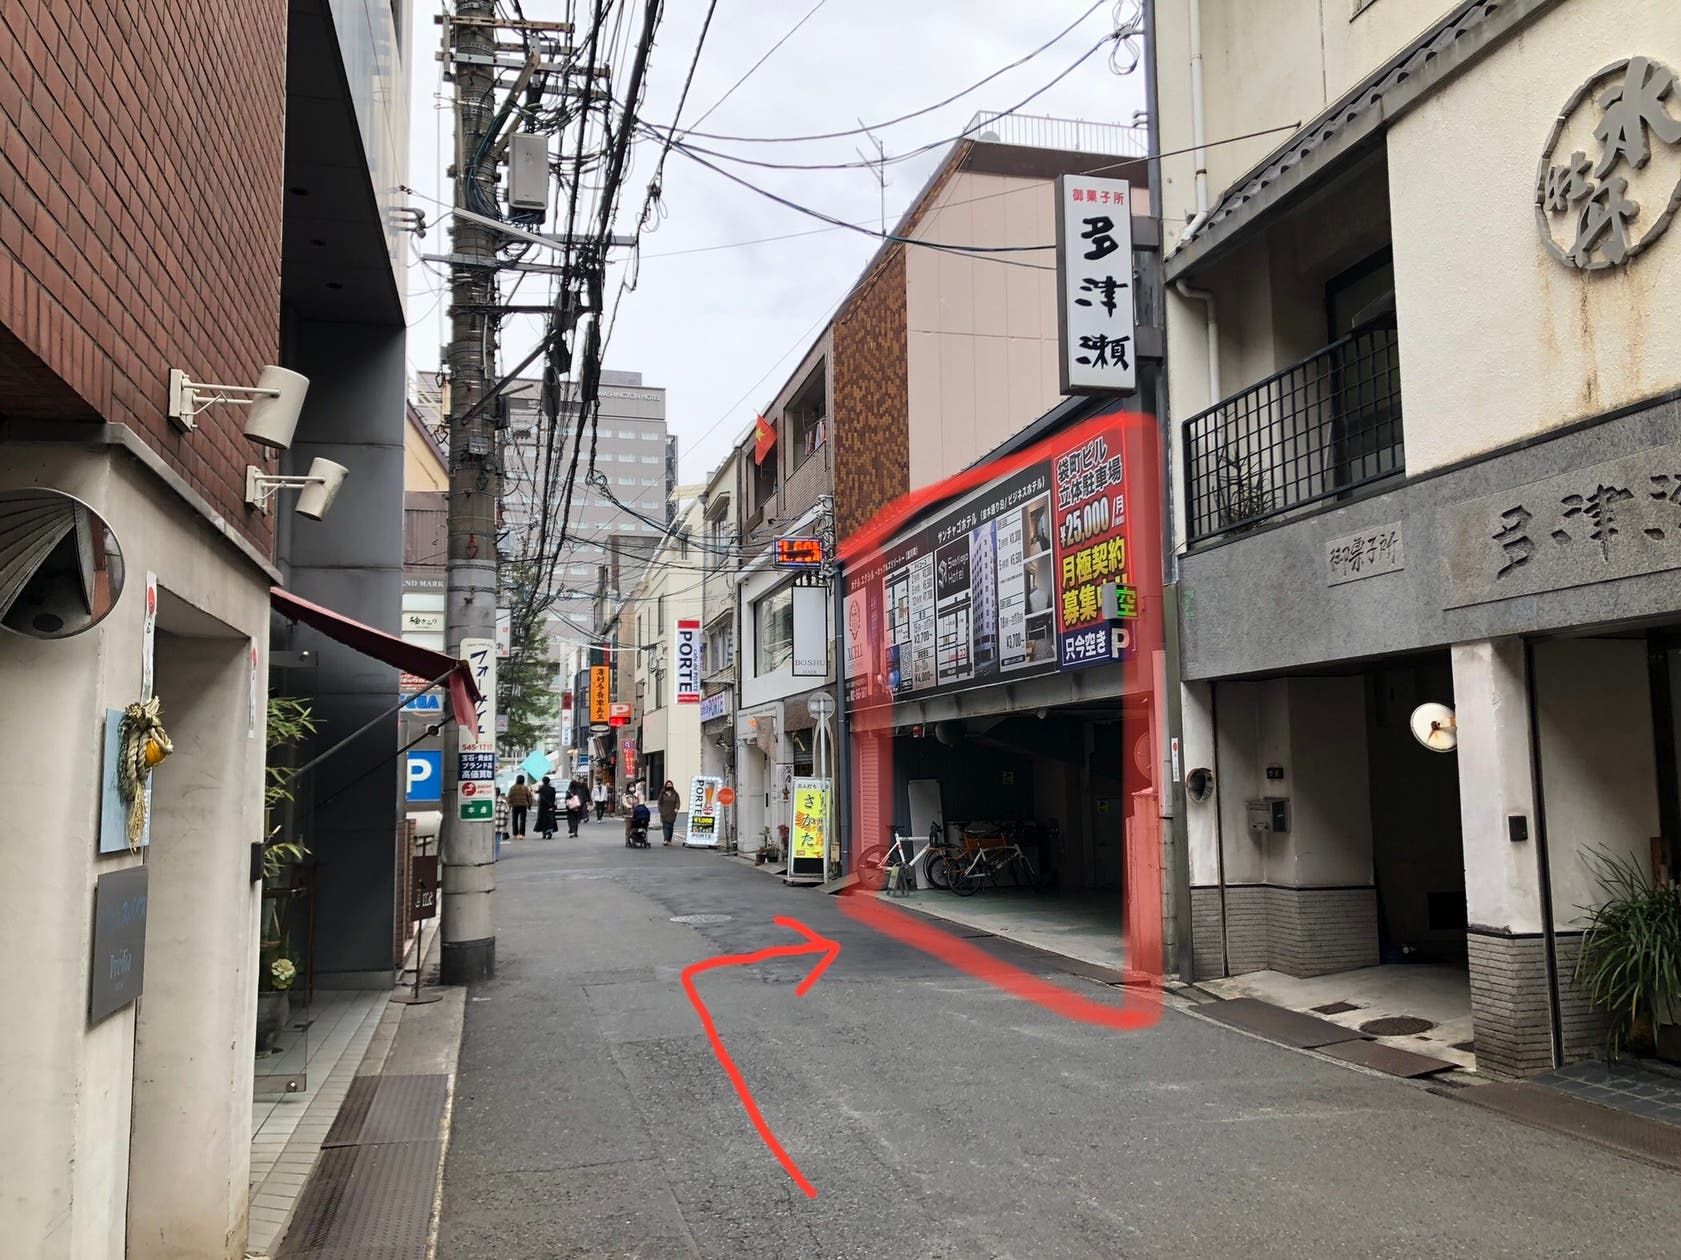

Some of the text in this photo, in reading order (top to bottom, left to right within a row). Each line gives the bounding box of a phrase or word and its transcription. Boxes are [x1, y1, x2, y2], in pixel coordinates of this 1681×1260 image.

[1072, 188, 1125, 205] 御菓子所
[1074, 216, 1130, 371] 多津瀬
[1058, 437, 1107, 485] 袋町ビル
[1058, 454, 1123, 511] 立体駐車場
[937, 512, 977, 544] サンチャゴホテル
[1059, 497, 1109, 548] ¥25,000
[1490, 474, 1681, 580] 多津
[1062, 541, 1126, 588] 月極契約
[1115, 586, 1137, 617] 空
[1065, 630, 1106, 660] 只今空き
[1111, 628, 1130, 659] P
[680, 631, 692, 692] PORTE
[611, 704, 629, 717] P
[406, 758, 432, 793] P
[462, 770, 492, 778] 高価買取
[695, 780, 705, 815] PORTE
[801, 794, 815, 847] さかた
